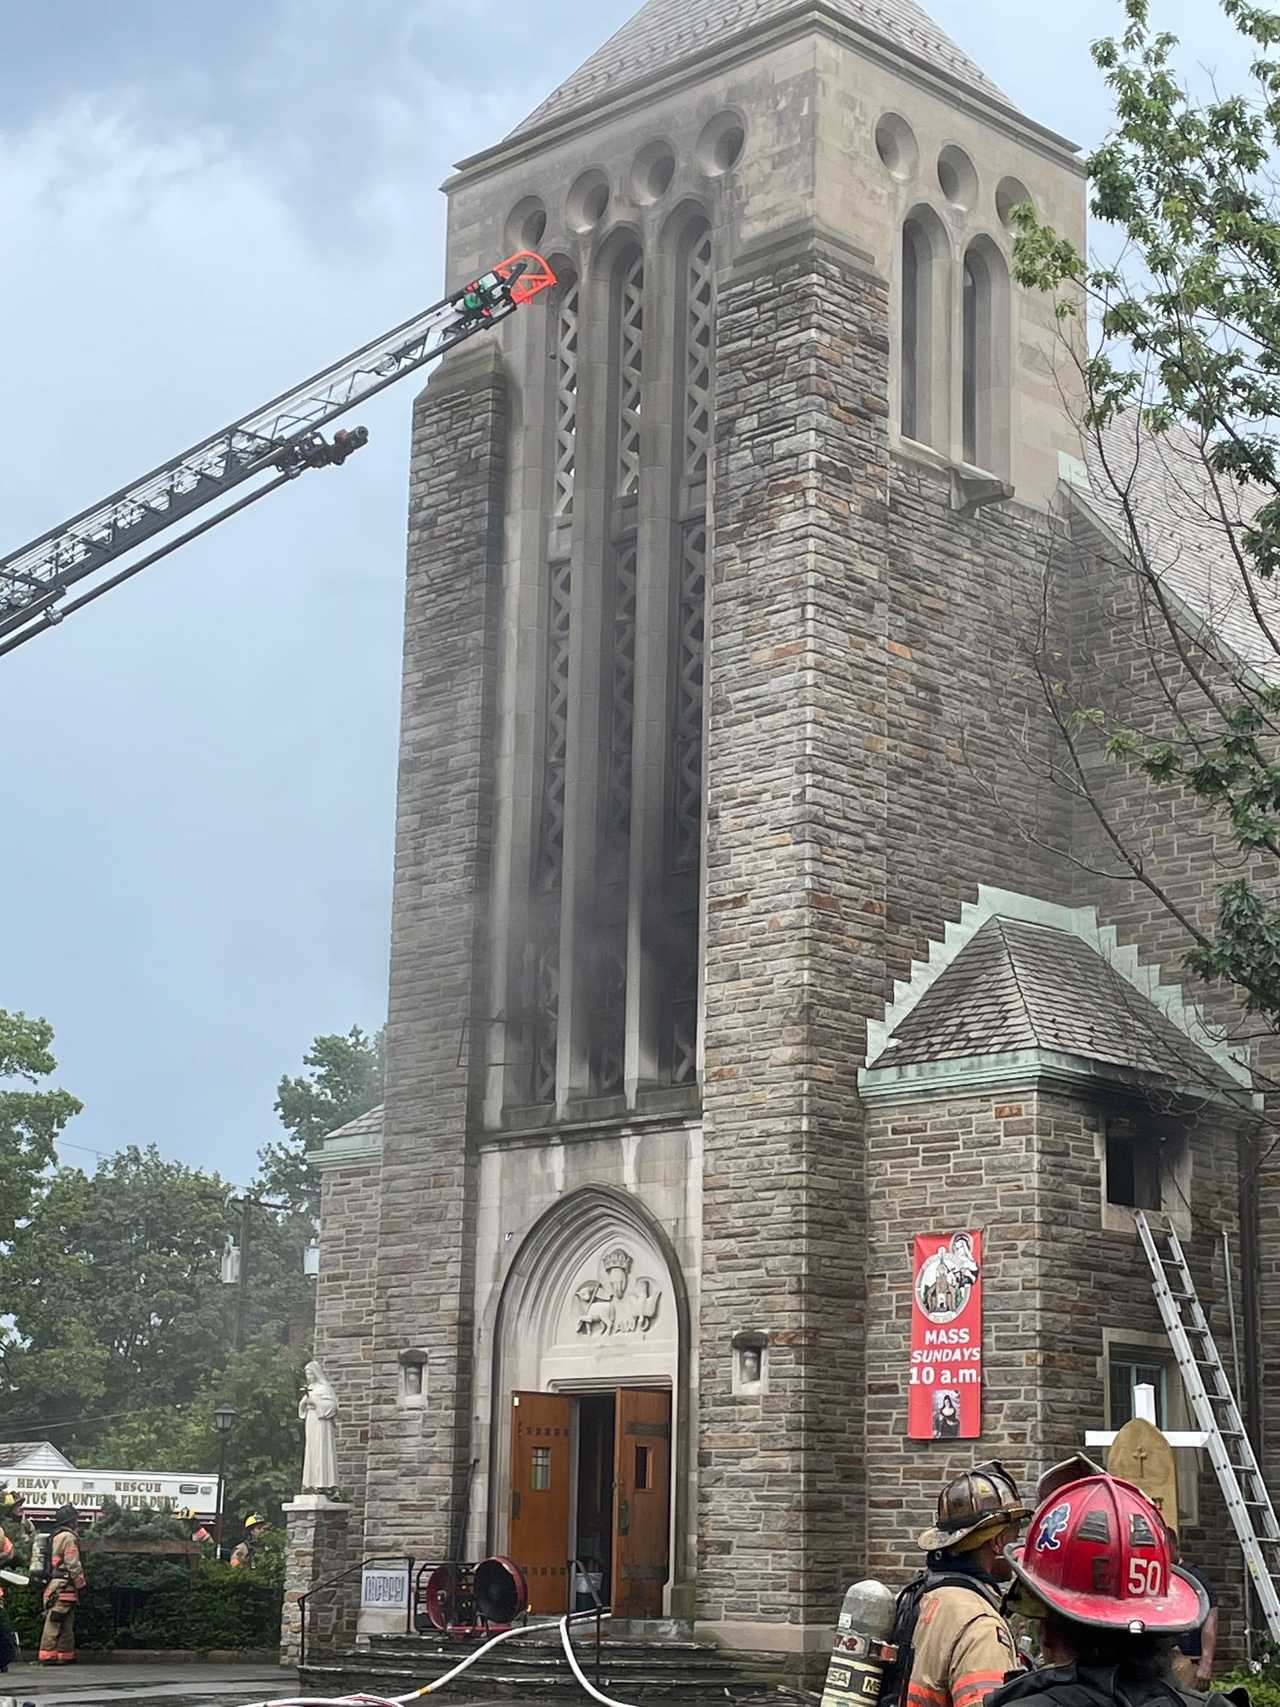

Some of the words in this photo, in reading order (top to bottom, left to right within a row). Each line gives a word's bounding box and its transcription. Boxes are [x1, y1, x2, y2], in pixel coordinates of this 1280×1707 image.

[925, 1328, 970, 1345] MASS
[911, 1347, 981, 1363] SUNDAYS
[909, 1366, 935, 1385] 10
[17, 1478, 60, 1489] HEAVY
[114, 1481, 162, 1493] RESCUE
[1128, 1557, 1161, 1595] 50
